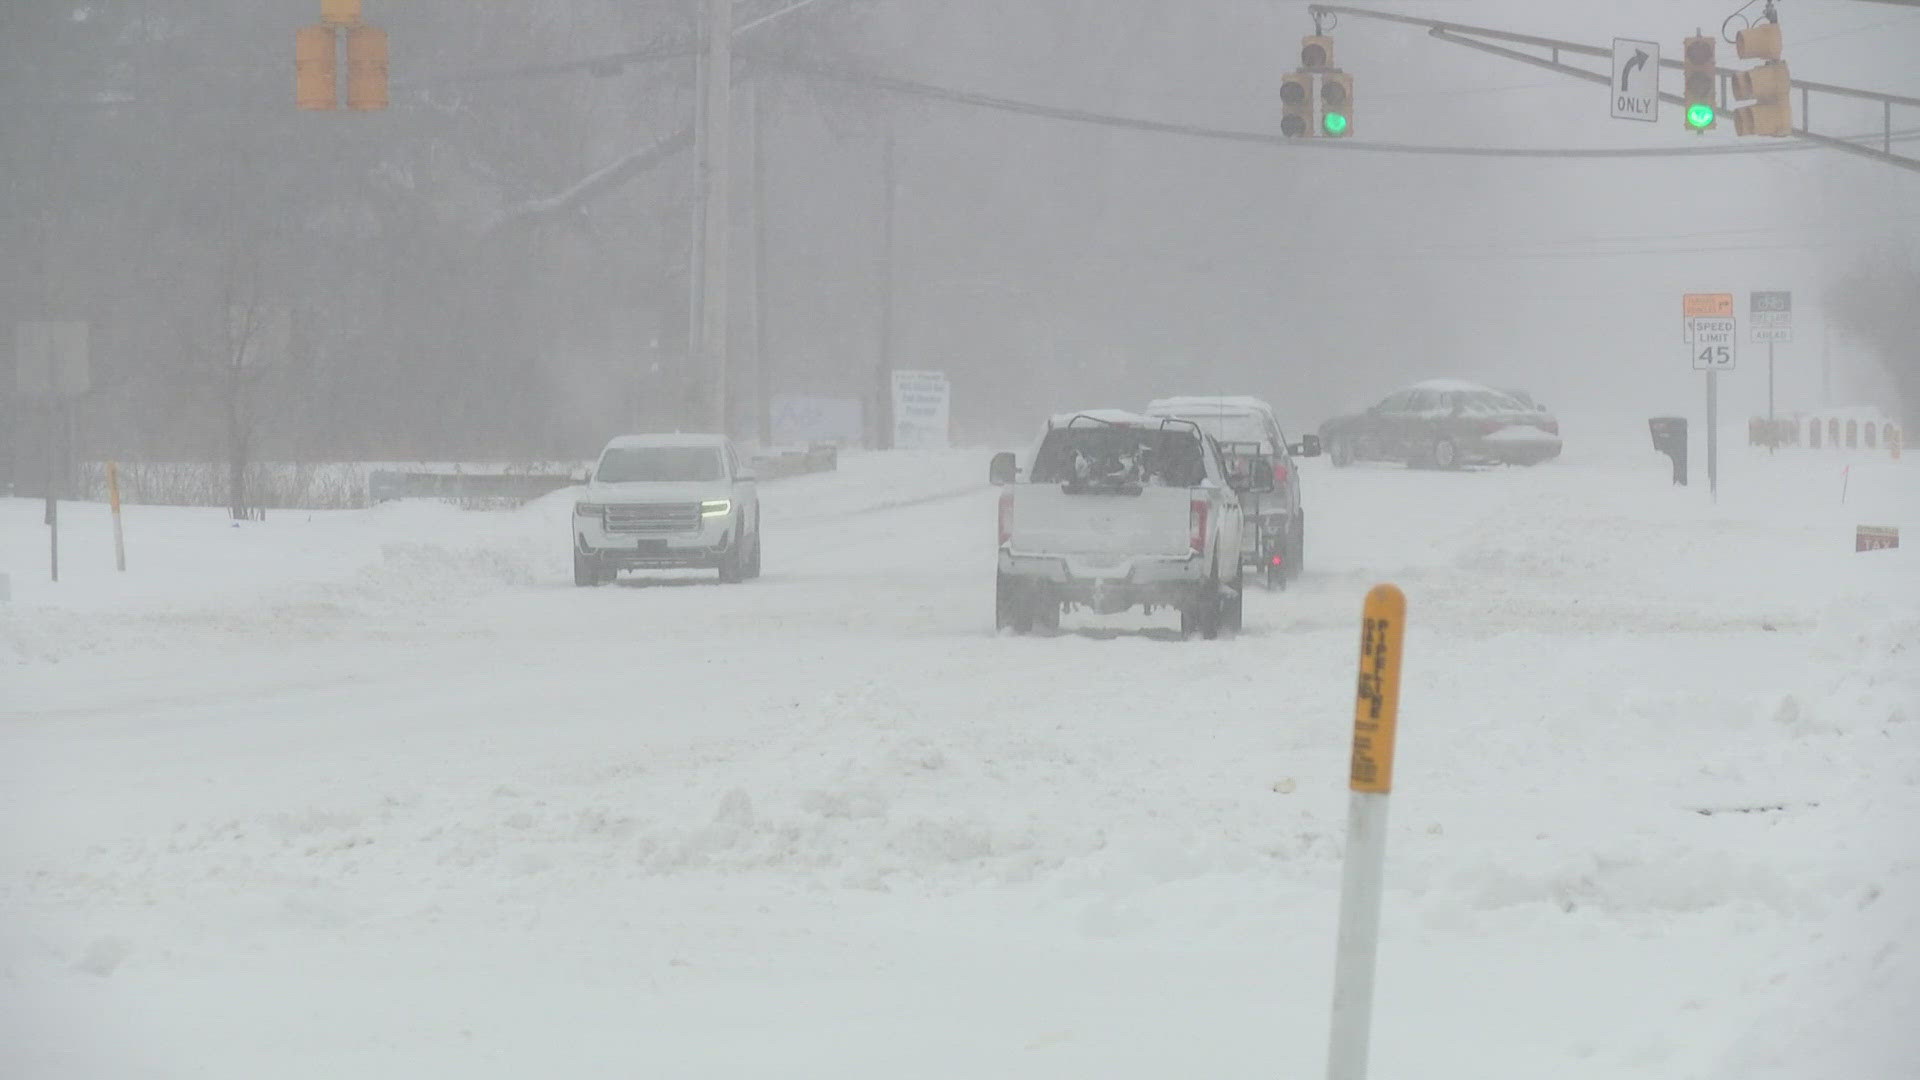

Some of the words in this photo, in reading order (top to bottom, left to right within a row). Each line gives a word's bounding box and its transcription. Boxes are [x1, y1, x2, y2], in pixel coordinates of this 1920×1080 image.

[1617, 96, 1651, 114] ONLY
[1696, 321, 1733, 332] SPEED
[1700, 333, 1729, 343] LIMIT
[1699, 346, 1730, 365] 45
